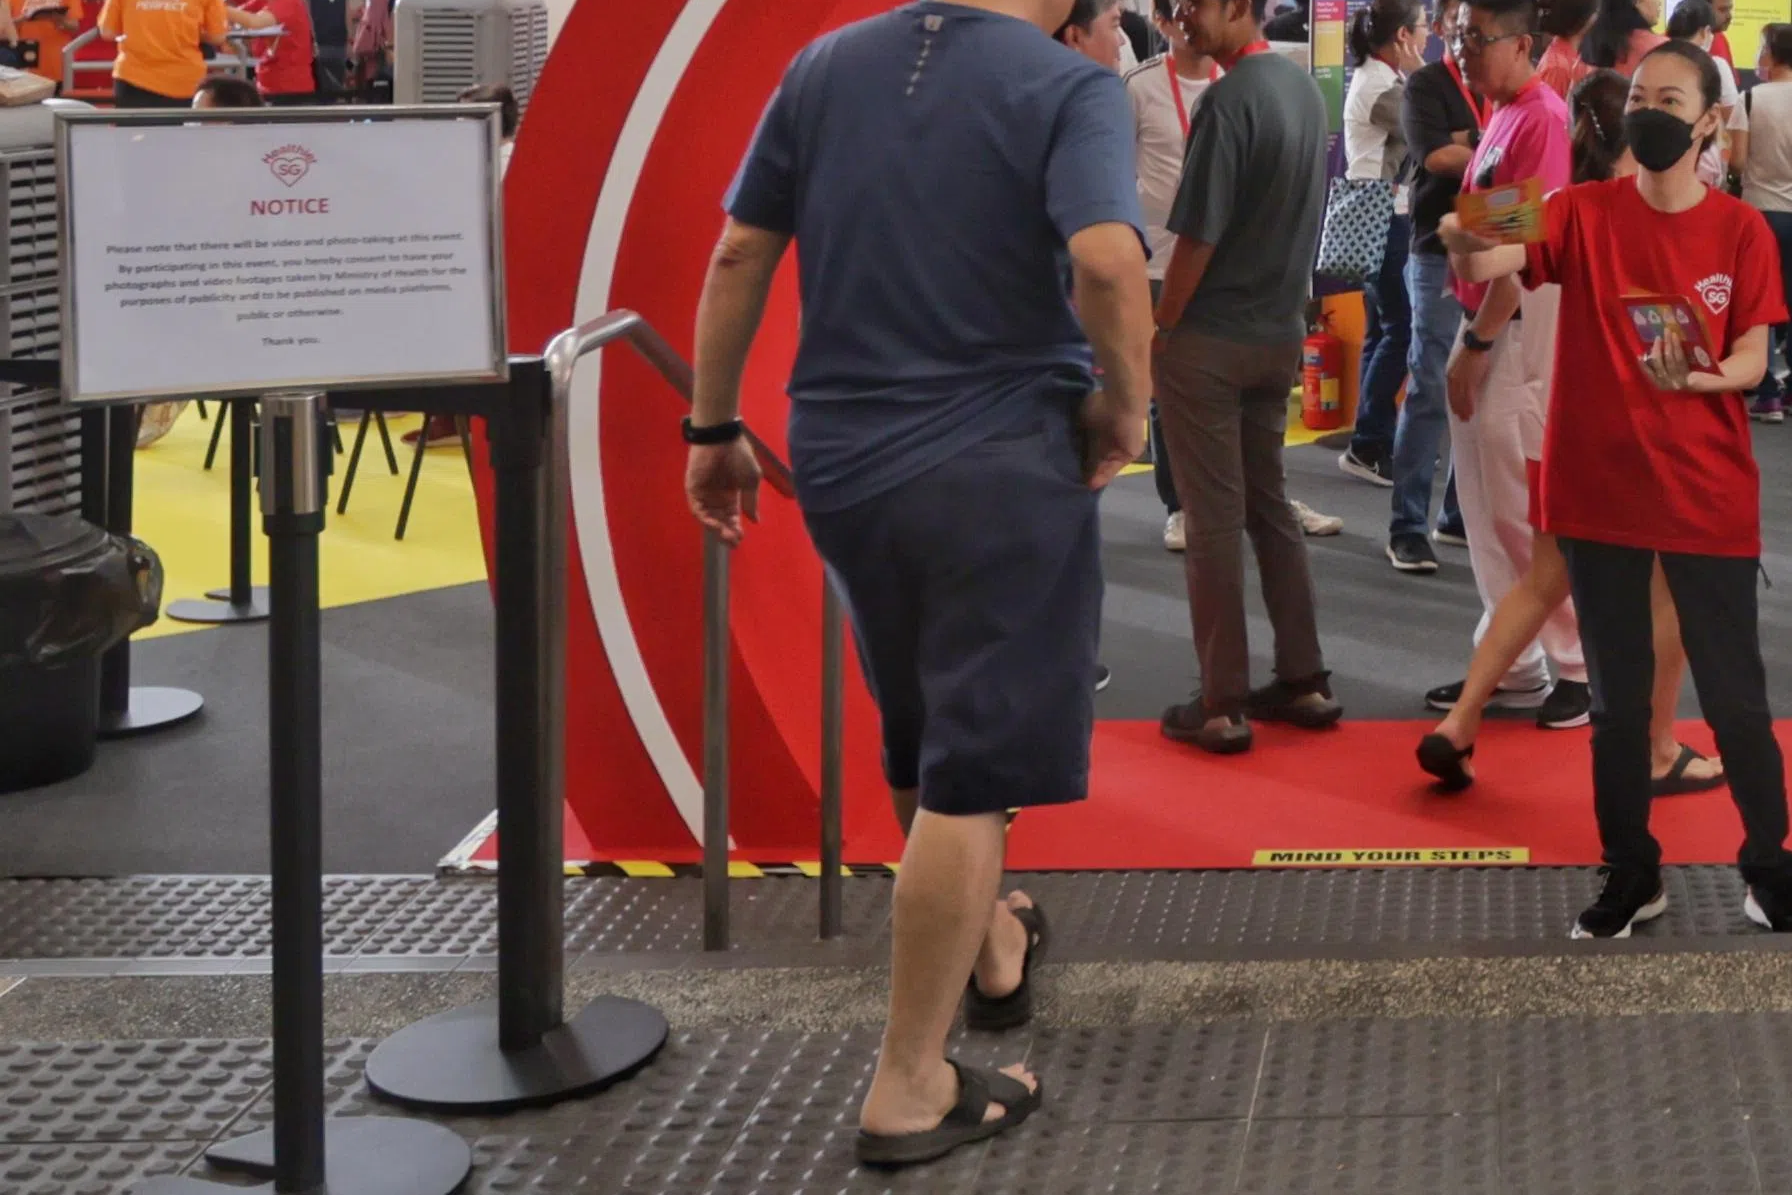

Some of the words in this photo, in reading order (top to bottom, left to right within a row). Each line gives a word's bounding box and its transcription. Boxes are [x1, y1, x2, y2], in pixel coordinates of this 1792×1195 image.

[261, 144, 317, 164] Healthier
[279, 164, 301, 176] SG
[251, 197, 329, 216] NOTICE
[146, 244, 171, 252] note
[174, 243, 197, 252] that
[200, 241, 229, 251] there
[255, 239, 268, 248] be
[272, 238, 301, 247] video
[304, 237, 324, 246] and
[118, 264, 132, 274] By
[135, 262, 206, 274] participating
[222, 260, 242, 269] this
[283, 258, 302, 267] you
[179, 278, 199, 287] and
[319, 272, 331, 282] by
[120, 297, 172, 308] purposes
[175, 295, 186, 304] of
[240, 291, 260, 300] and
[1707, 292, 1726, 305] SG
[1269, 851, 1343, 862] MIND
[1352, 851, 1421, 862] YOUR
[1430, 850, 1512, 861] STEPS
